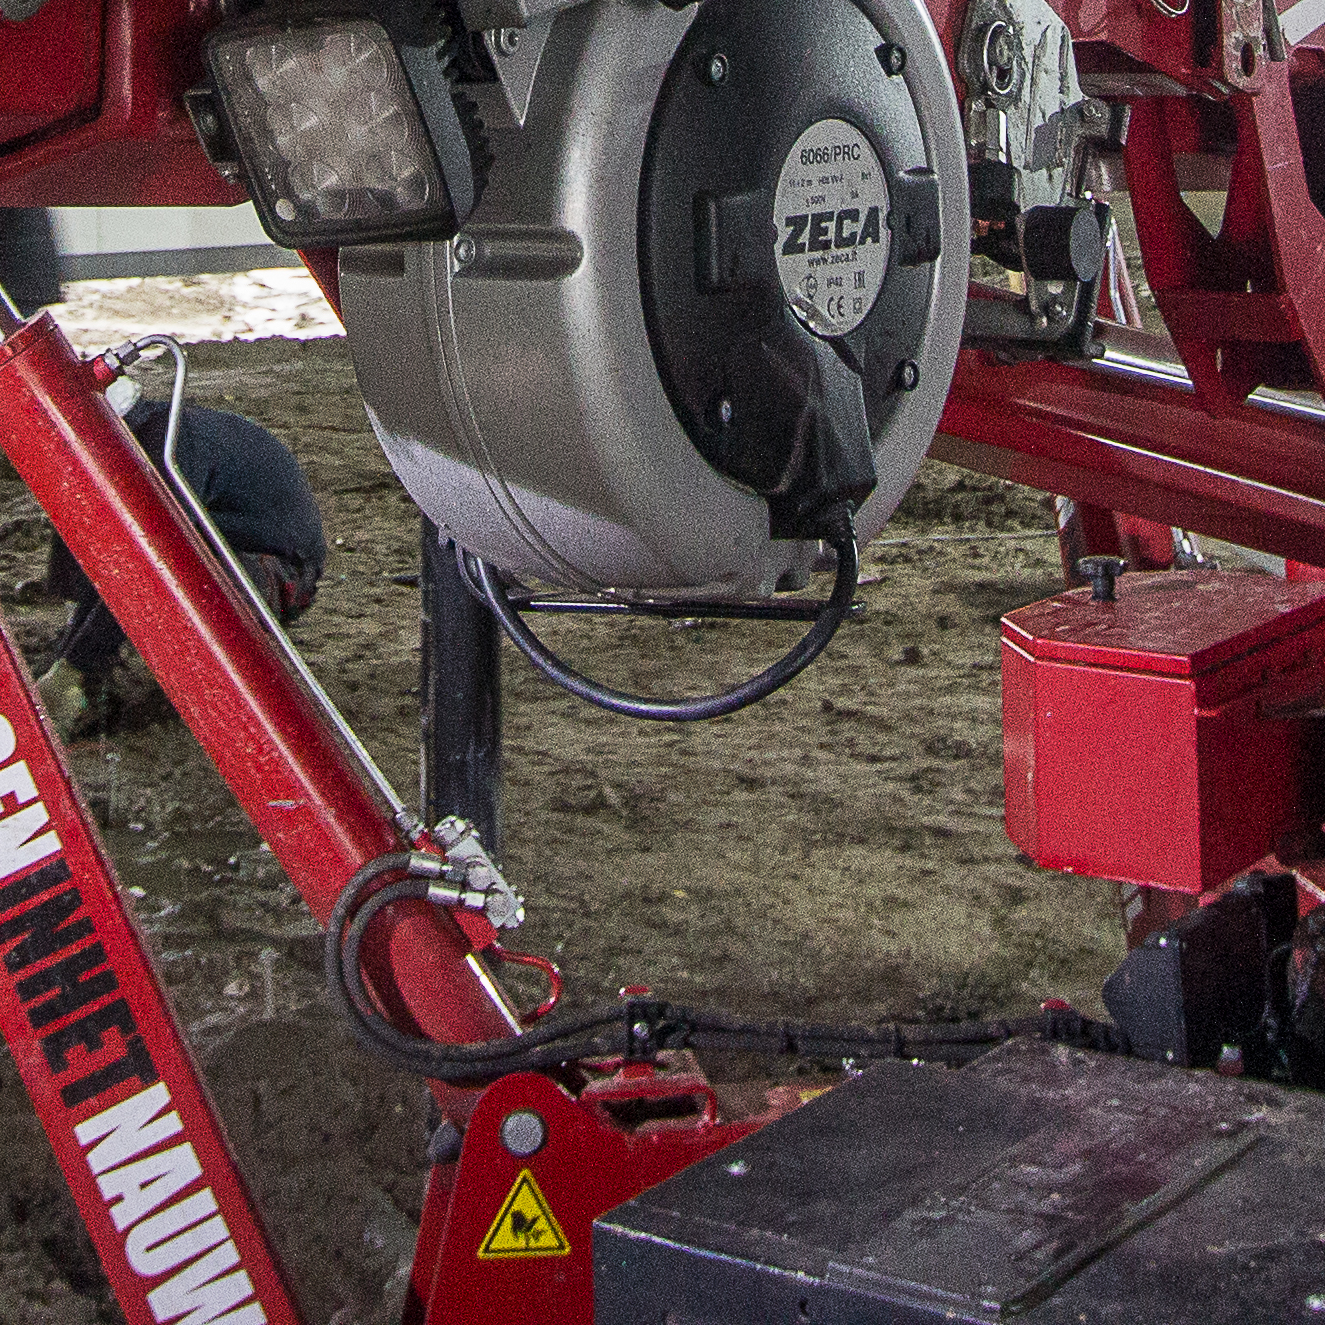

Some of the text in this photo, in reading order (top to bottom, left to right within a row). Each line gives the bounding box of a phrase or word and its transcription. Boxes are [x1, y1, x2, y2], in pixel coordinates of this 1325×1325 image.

[800, 143, 861, 165] 6066/PRC
[782, 205, 881, 256] ZECA
[808, 249, 858, 268] www.zeca.it
